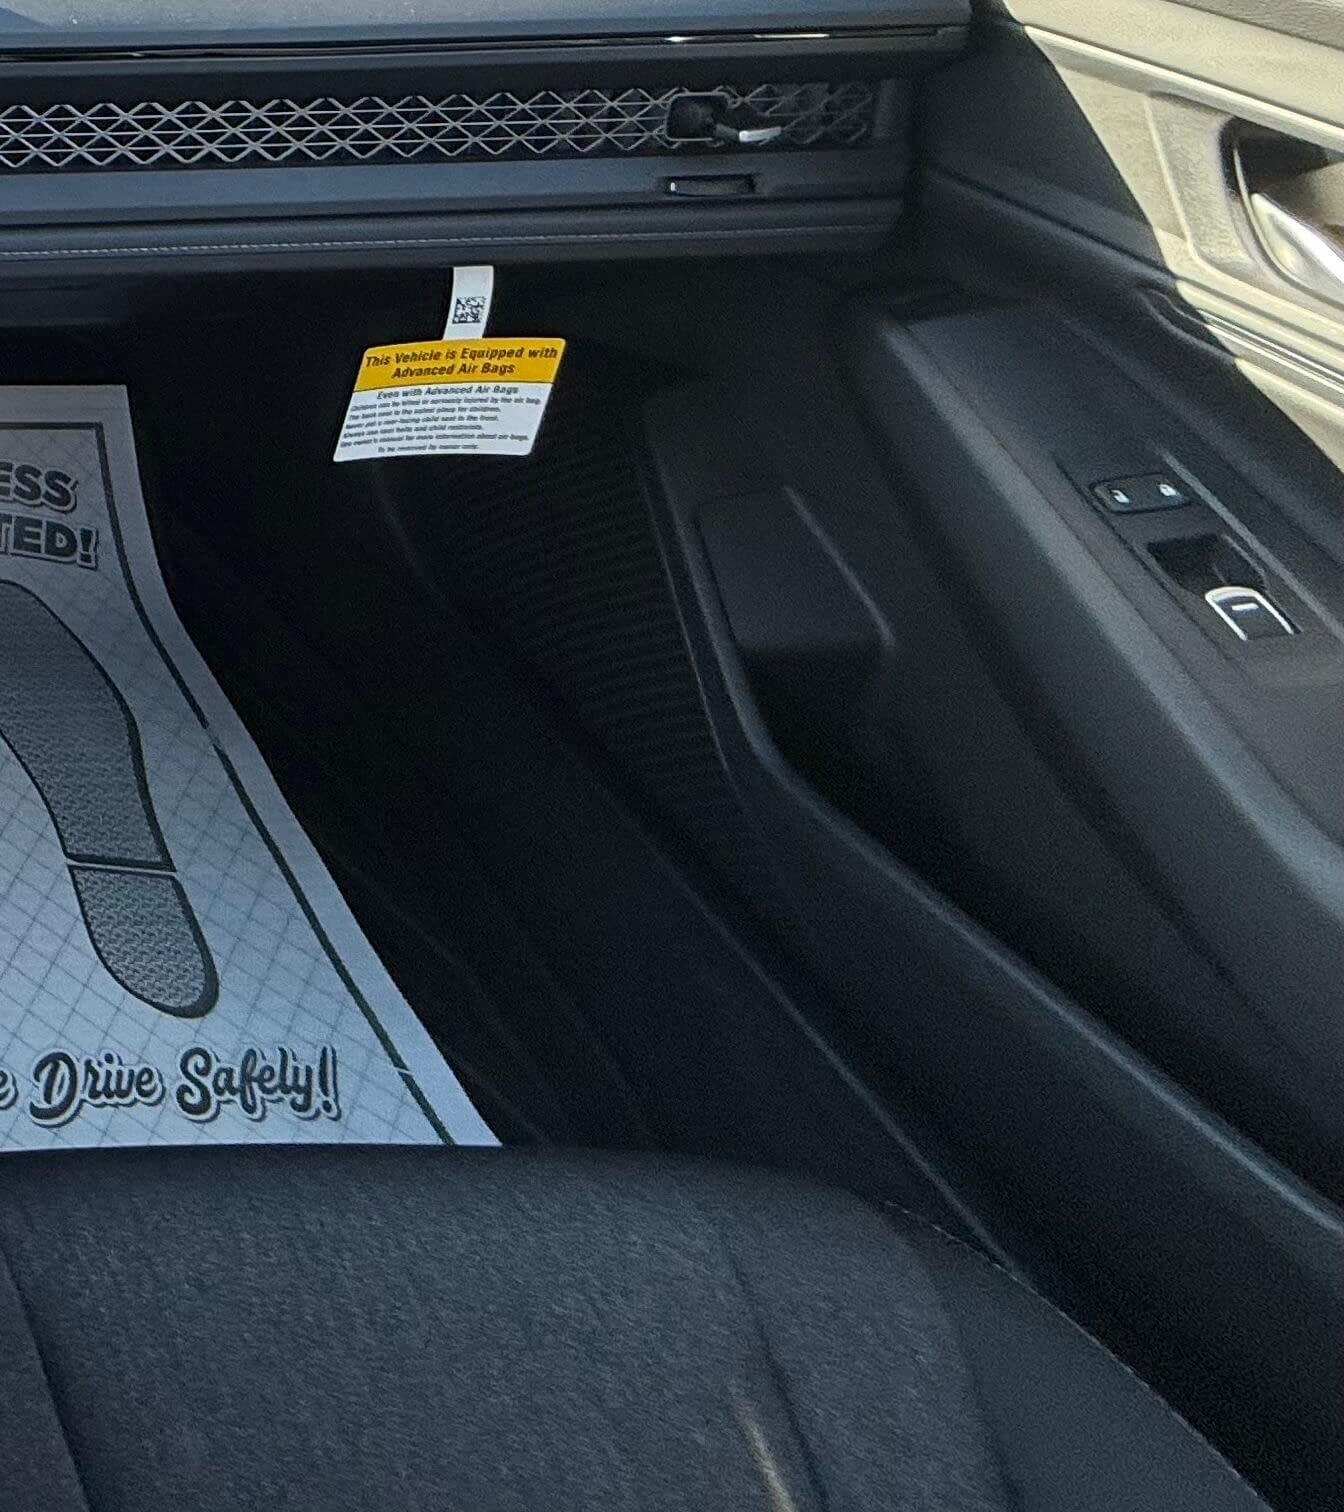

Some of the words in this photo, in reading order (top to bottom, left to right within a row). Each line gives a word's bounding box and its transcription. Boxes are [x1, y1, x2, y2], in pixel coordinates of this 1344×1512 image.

[365, 354, 391, 368] This
[395, 349, 441, 364] Vehicle
[445, 349, 456, 359] is
[461, 347, 524, 361] Equipped
[528, 347, 558, 358] with
[391, 363, 455, 378] Advanced
[457, 363, 477, 374] Air
[480, 362, 515, 376] Bags
[424, 386, 472, 396] Advanced
[475, 386, 490, 394] Air
[28, 1050, 160, 1122] Drive
[175, 1046, 335, 1118] Safely!
